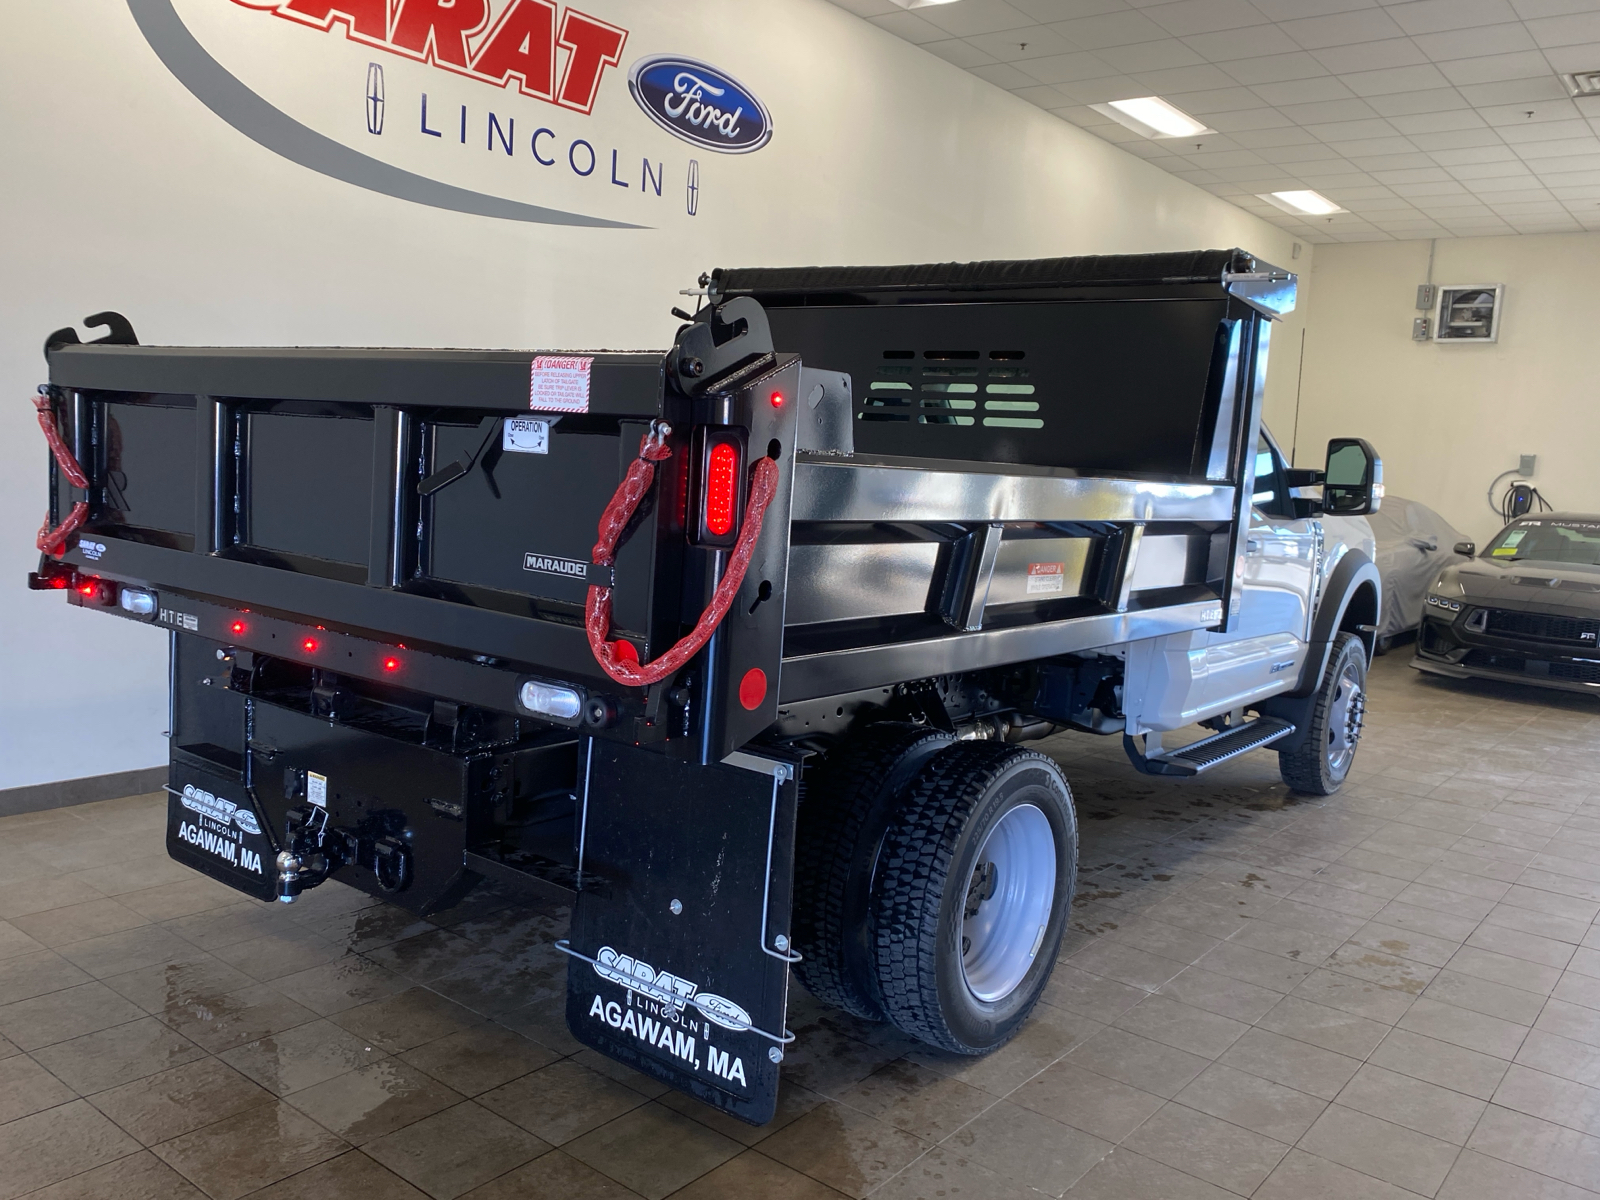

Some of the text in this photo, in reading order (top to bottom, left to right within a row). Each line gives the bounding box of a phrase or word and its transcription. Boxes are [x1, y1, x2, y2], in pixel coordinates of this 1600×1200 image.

[229, 0, 629, 116] RAT
[663, 72, 744, 138] Ford
[420, 92, 663, 197] LINCOLN
[510, 420, 543, 433] OPERATION
[178, 820, 238, 867] AGAWAM,
[240, 847, 262, 875] MA
[204, 818, 237, 839] LINCOLN
[592, 945, 698, 1011] SARAT
[589, 994, 747, 1087] AGAWAM, MA
